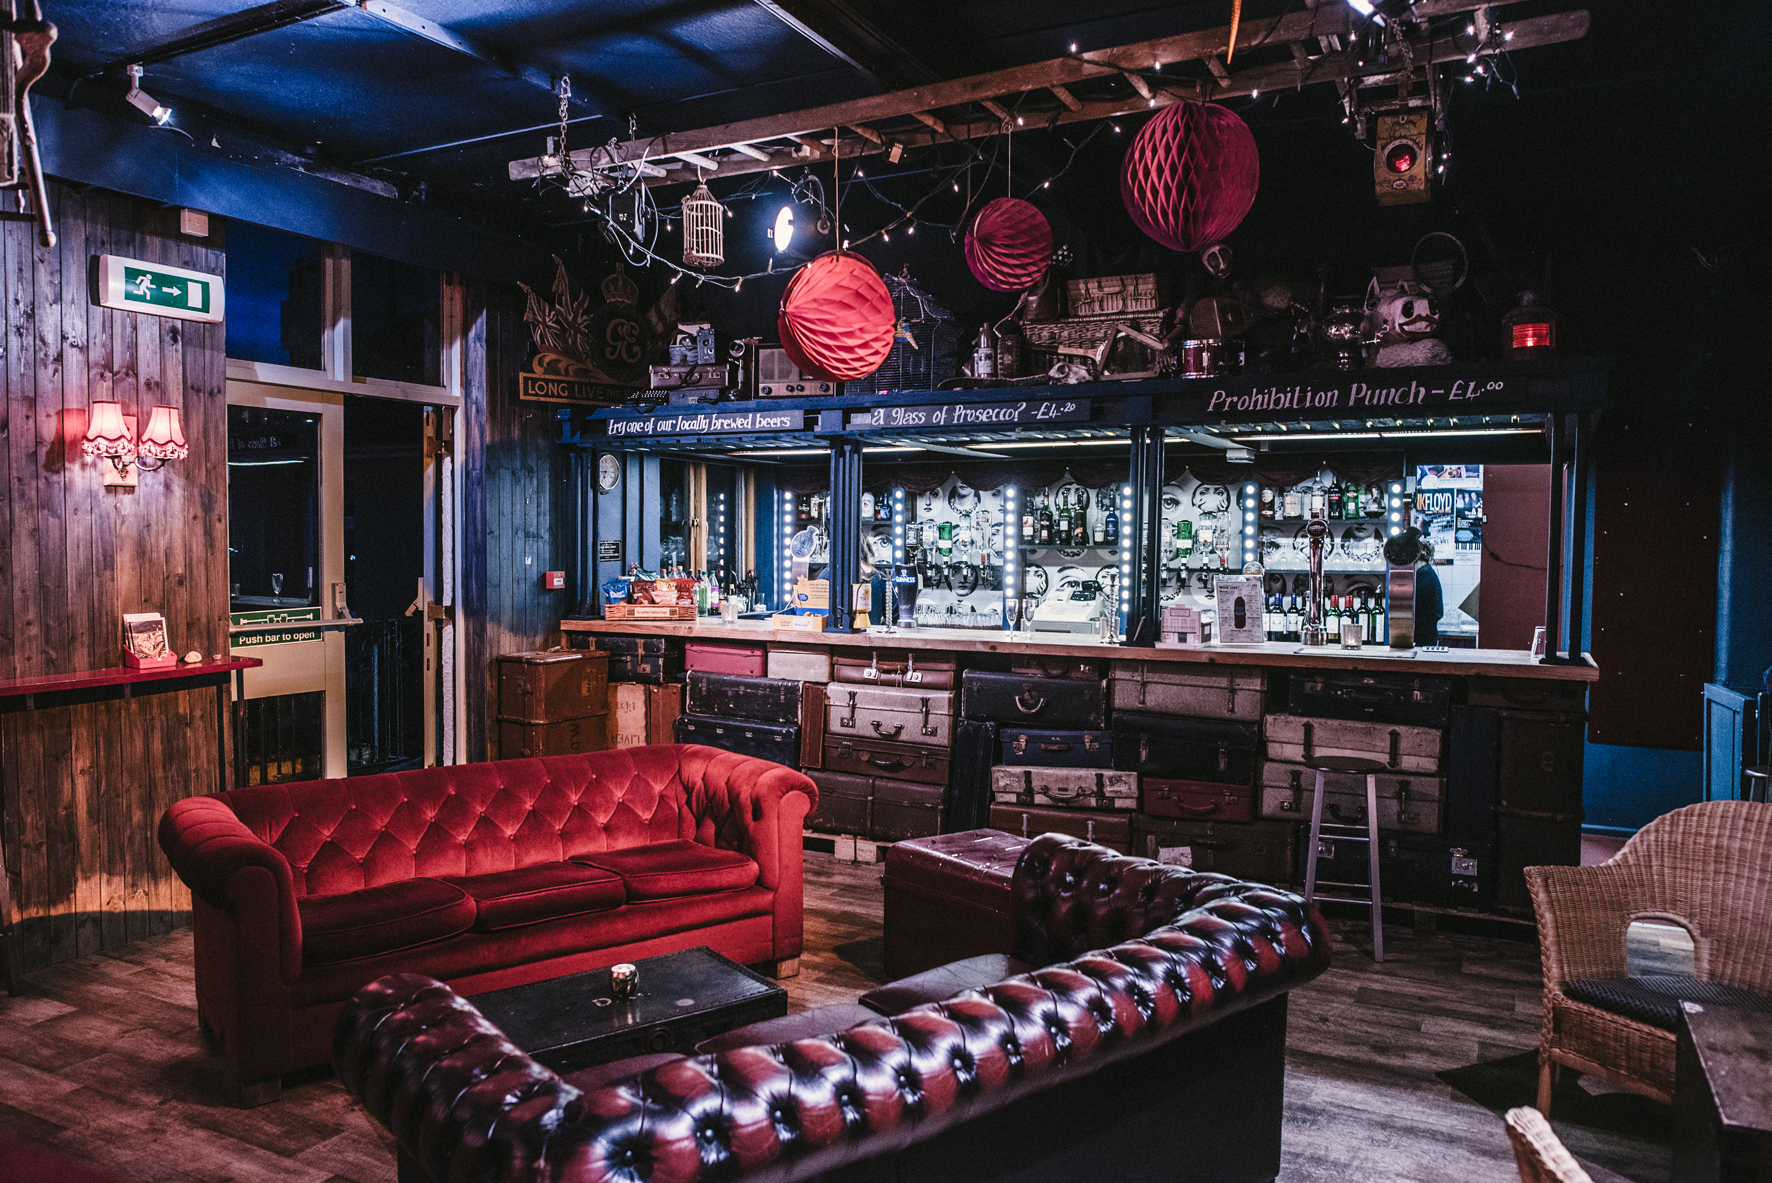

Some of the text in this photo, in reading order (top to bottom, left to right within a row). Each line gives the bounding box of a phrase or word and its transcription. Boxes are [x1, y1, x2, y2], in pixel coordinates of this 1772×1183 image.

[528, 380, 568, 397] LONG
[575, 384, 604, 399] LIVE
[1207, 387, 1339, 412] Prohibition
[1348, 381, 1426, 407] Punch
[627, 421, 644, 434] one
[644, 417, 655, 435] of
[657, 419, 677, 432] our
[676, 414, 710, 434] locally
[710, 413, 753, 431] brewed
[755, 413, 791, 429] beers
[891, 407, 926, 427] glass
[932, 405, 949, 426] of
[952, 402, 1026, 424] Prosecco?
[239, 631, 315, 645] Push bar to open
